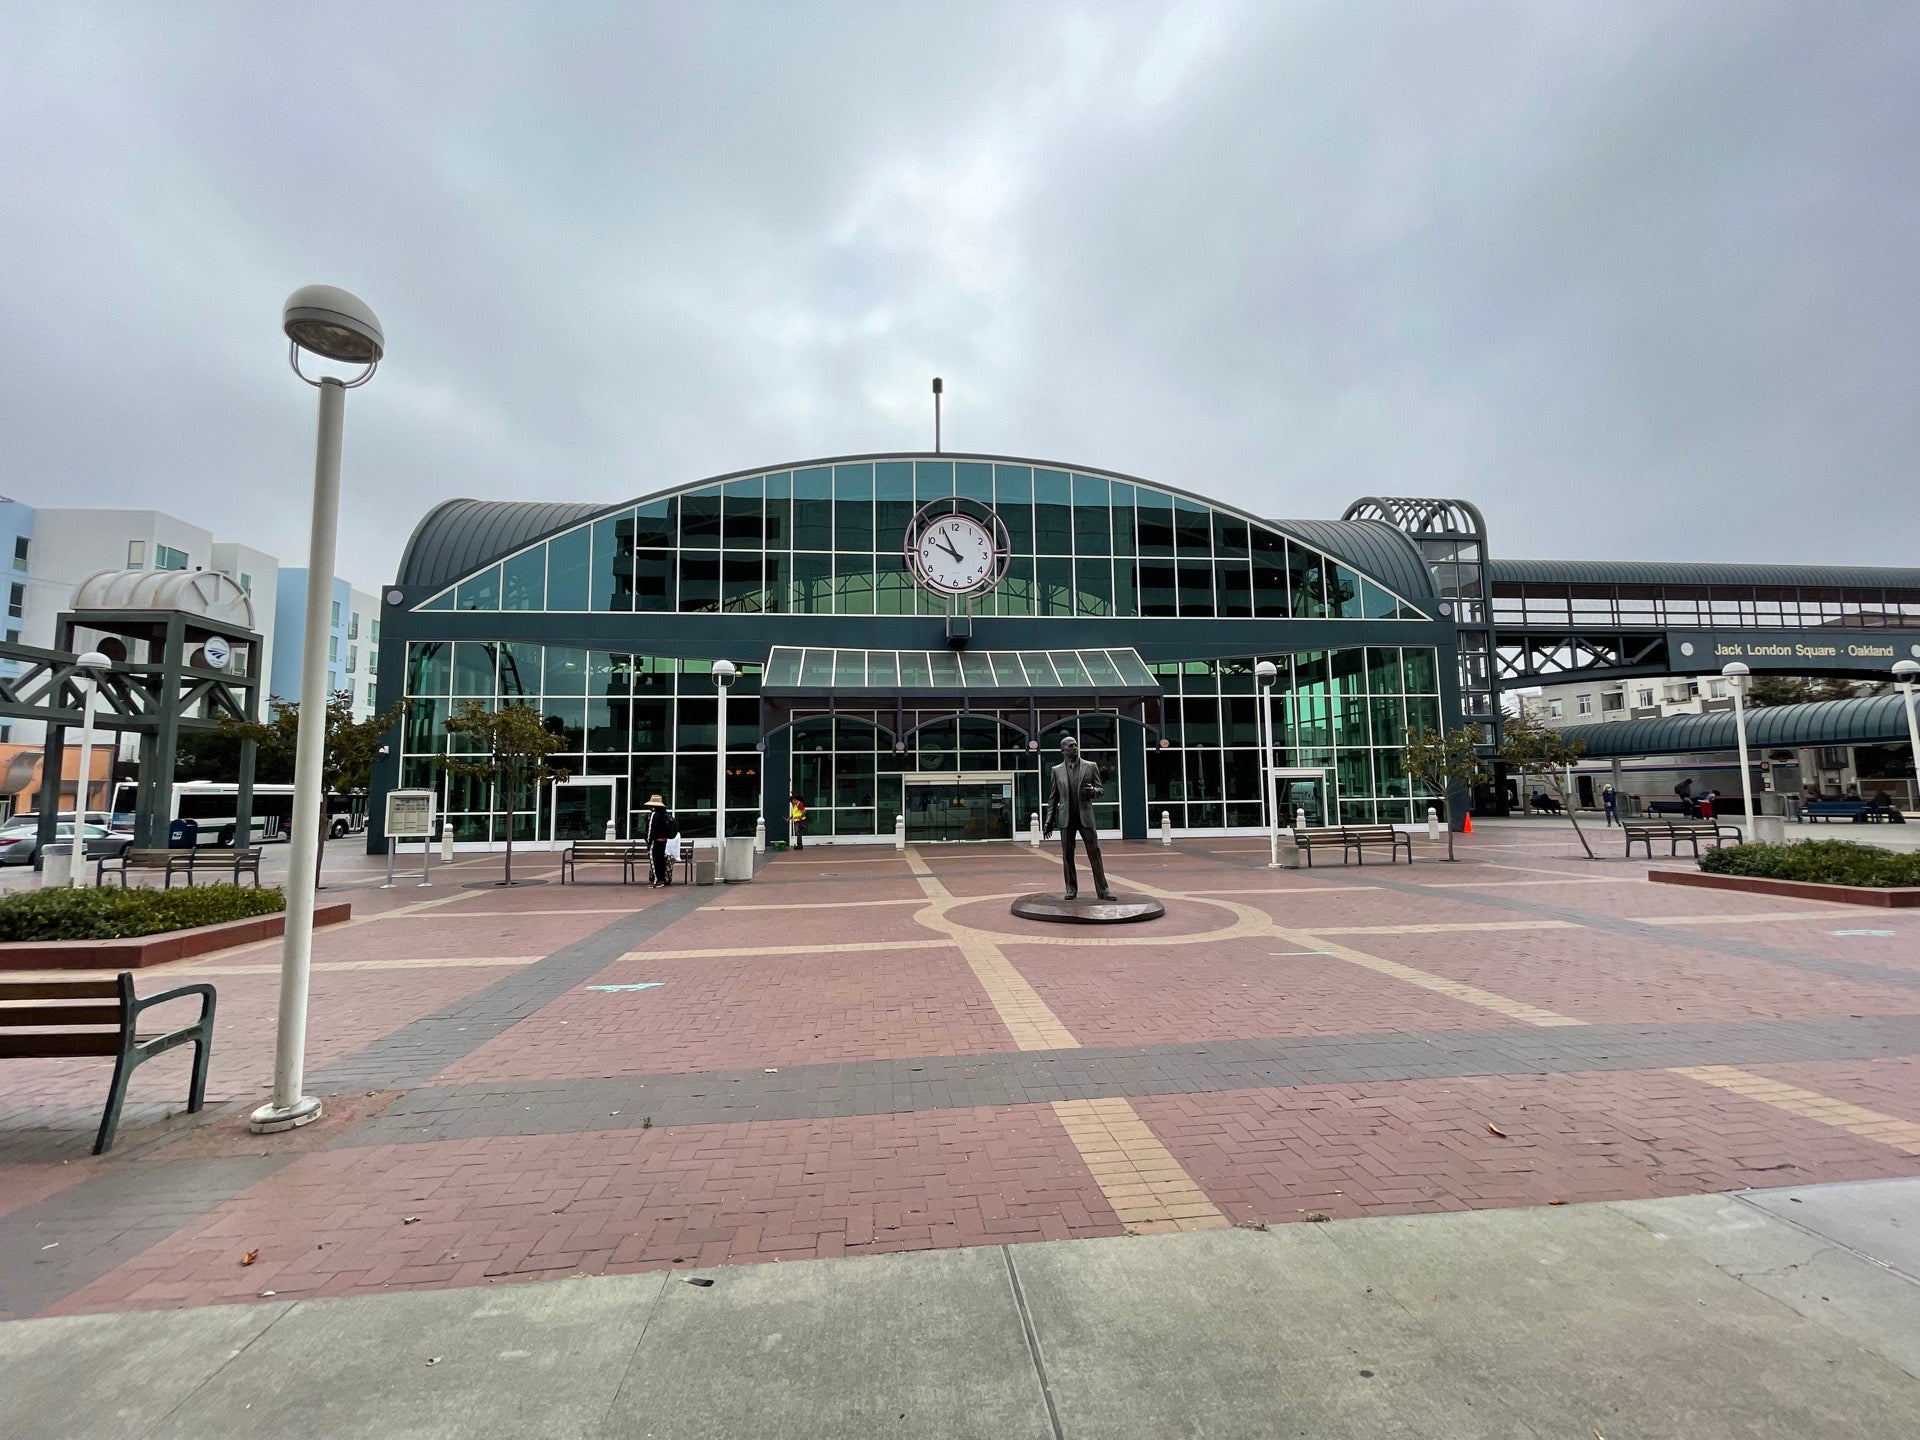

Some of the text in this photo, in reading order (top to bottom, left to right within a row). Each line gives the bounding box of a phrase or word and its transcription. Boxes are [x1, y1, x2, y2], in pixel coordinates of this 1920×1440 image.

[951, 523, 960, 531] 12
[928, 536, 936, 544] 10
[977, 537, 983, 545] 2
[923, 550, 929, 558] 9
[982, 552, 988, 560] 3
[927, 565, 933, 573] 8
[977, 566, 983, 574] 4
[939, 575, 944, 583] 7
[952, 579, 959, 587] 6
[966, 576, 973, 584] 5
[1714, 643, 1894, 659] Jack London Square Oakland
